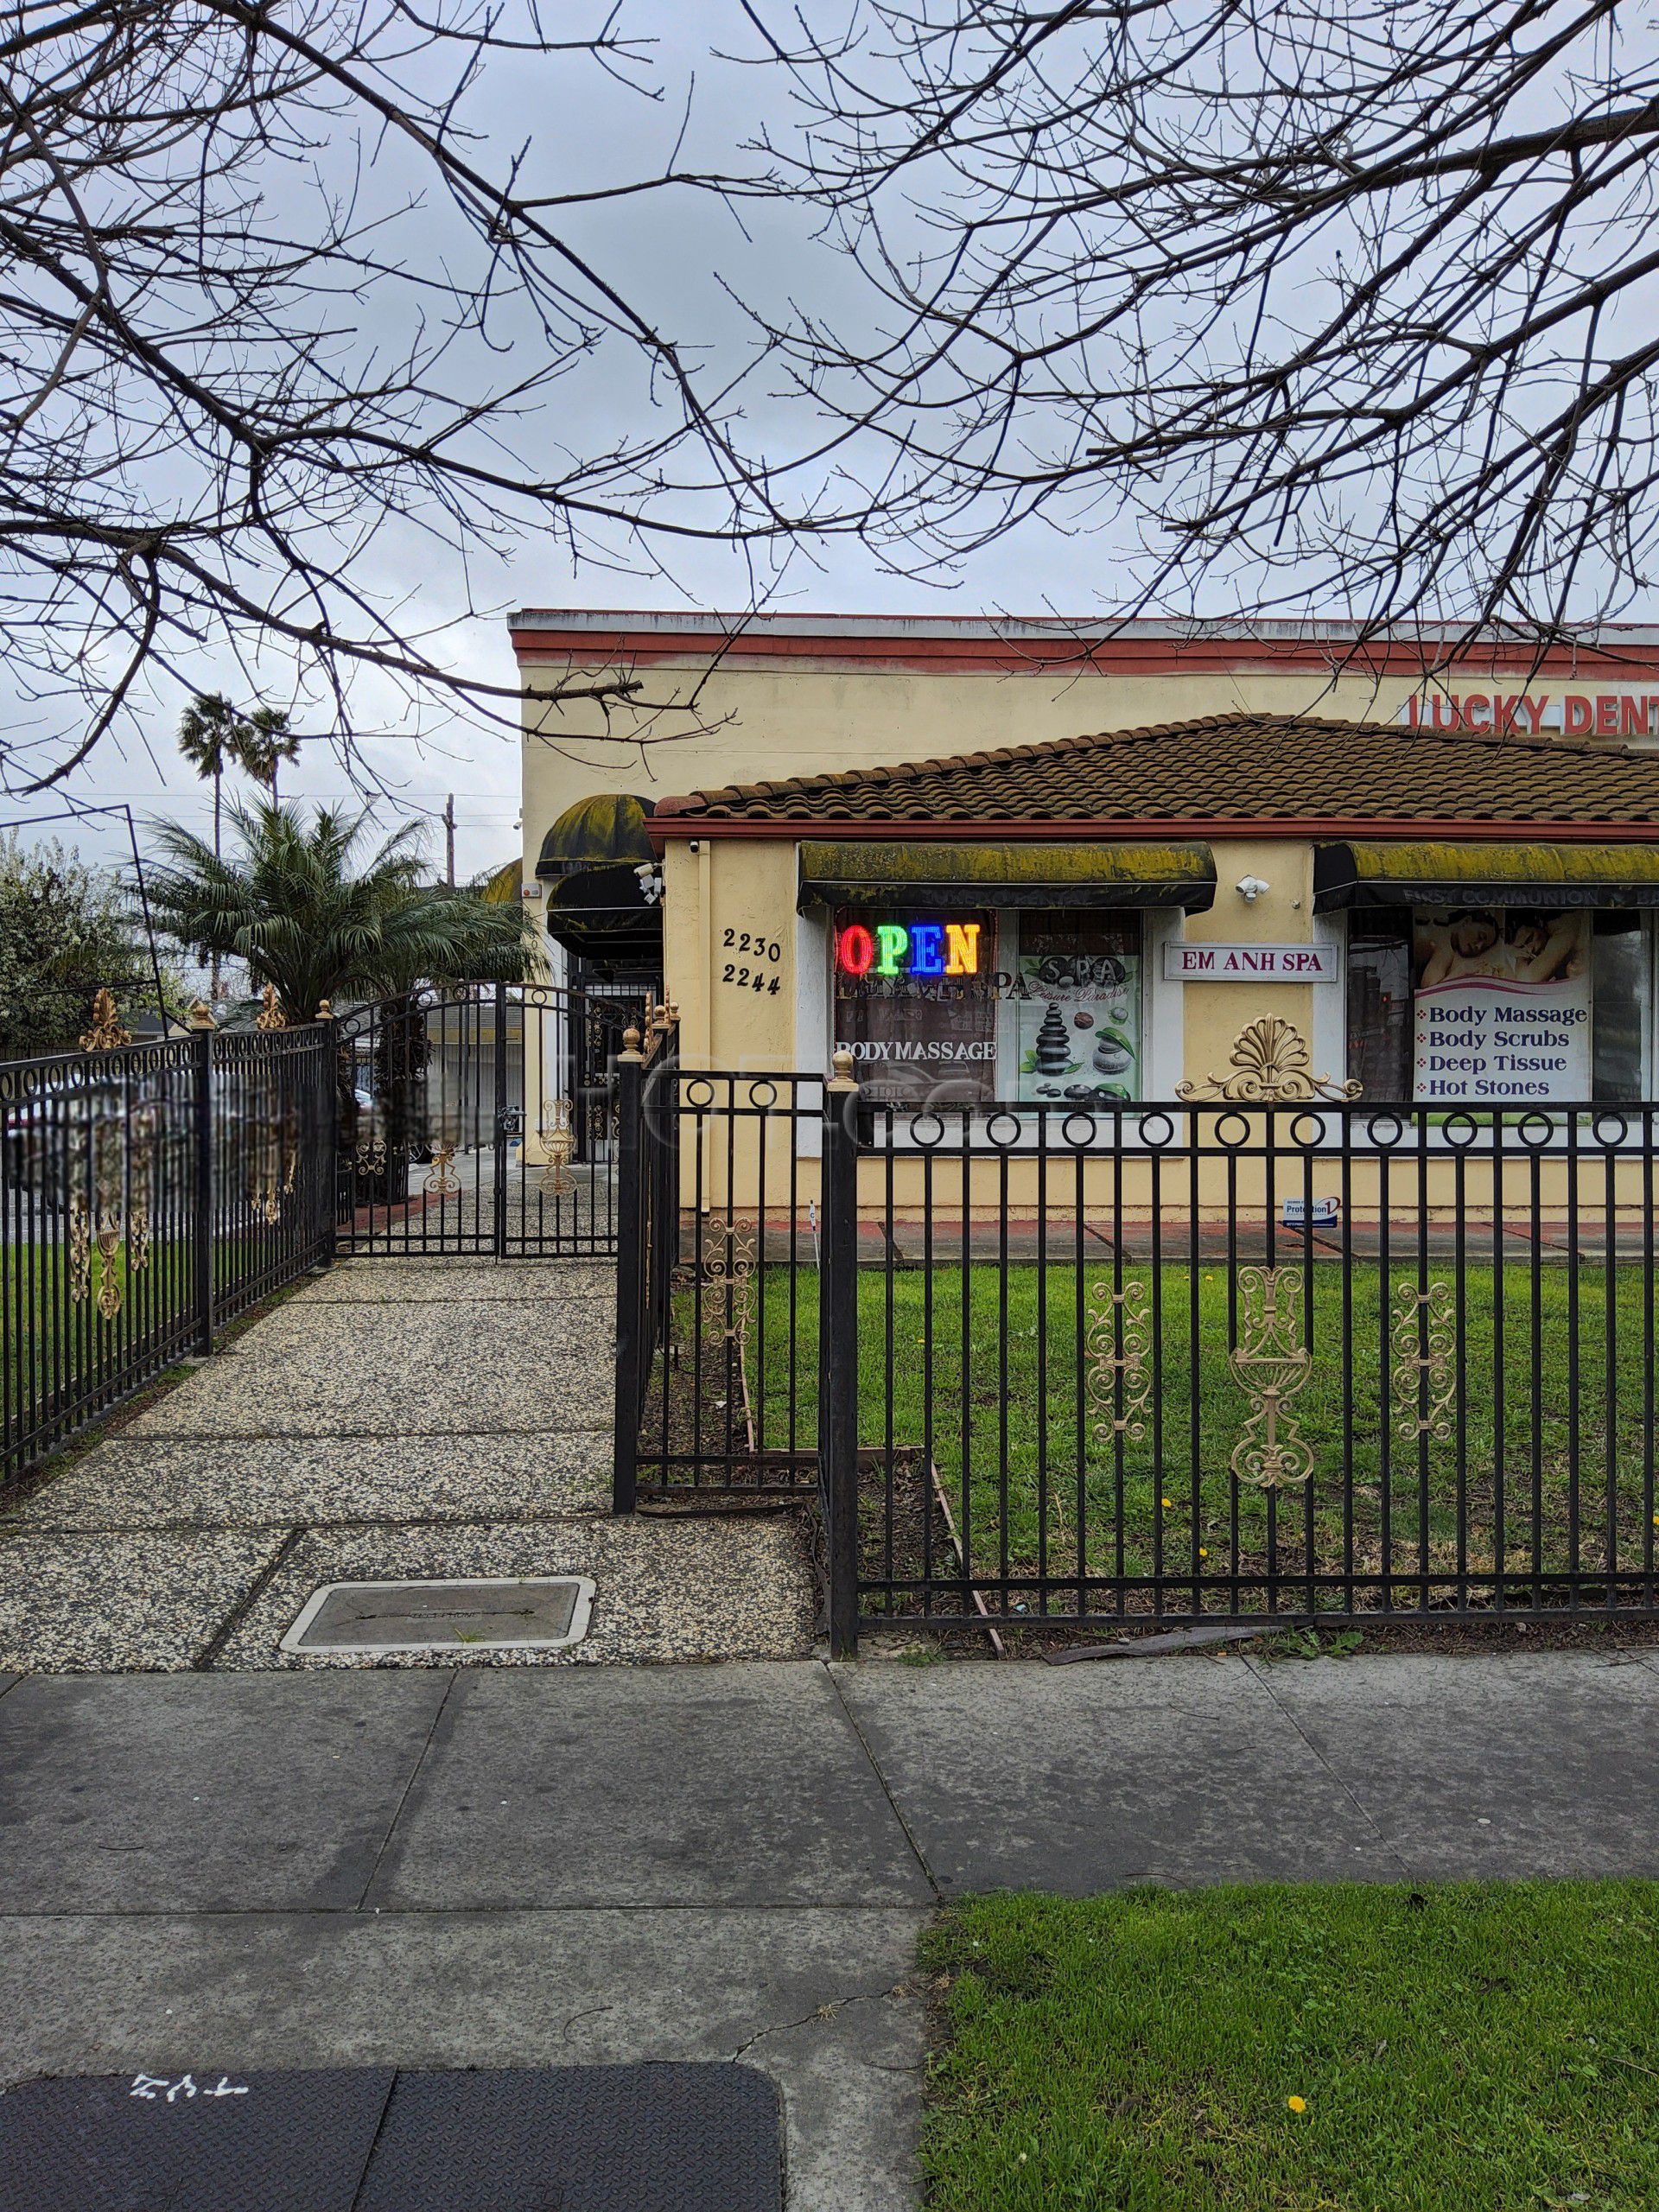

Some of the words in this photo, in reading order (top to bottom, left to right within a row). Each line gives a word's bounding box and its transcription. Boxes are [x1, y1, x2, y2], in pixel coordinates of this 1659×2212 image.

[1408, 693, 1550, 735] LUCKY
[722, 928, 781, 963] 2230
[840, 923, 982, 976] OPEN
[1181, 951, 1215, 970] EM
[1223, 951, 1275, 971] ANH
[1282, 952, 1323, 971] SPA
[721, 963, 781, 995] 2244
[1427, 1005, 1487, 1027] Body
[1494, 1006, 1588, 1027] Massage
[894, 1041, 996, 1061] MASSAGE
[1427, 1029, 1487, 1051] Body
[1494, 1030, 1570, 1048] Scrubs
[1427, 1054, 1487, 1075] Deep
[1494, 1054, 1567, 1072] Tissue
[1427, 1077, 1469, 1096] Hot
[1474, 1078, 1550, 1096] Stones
